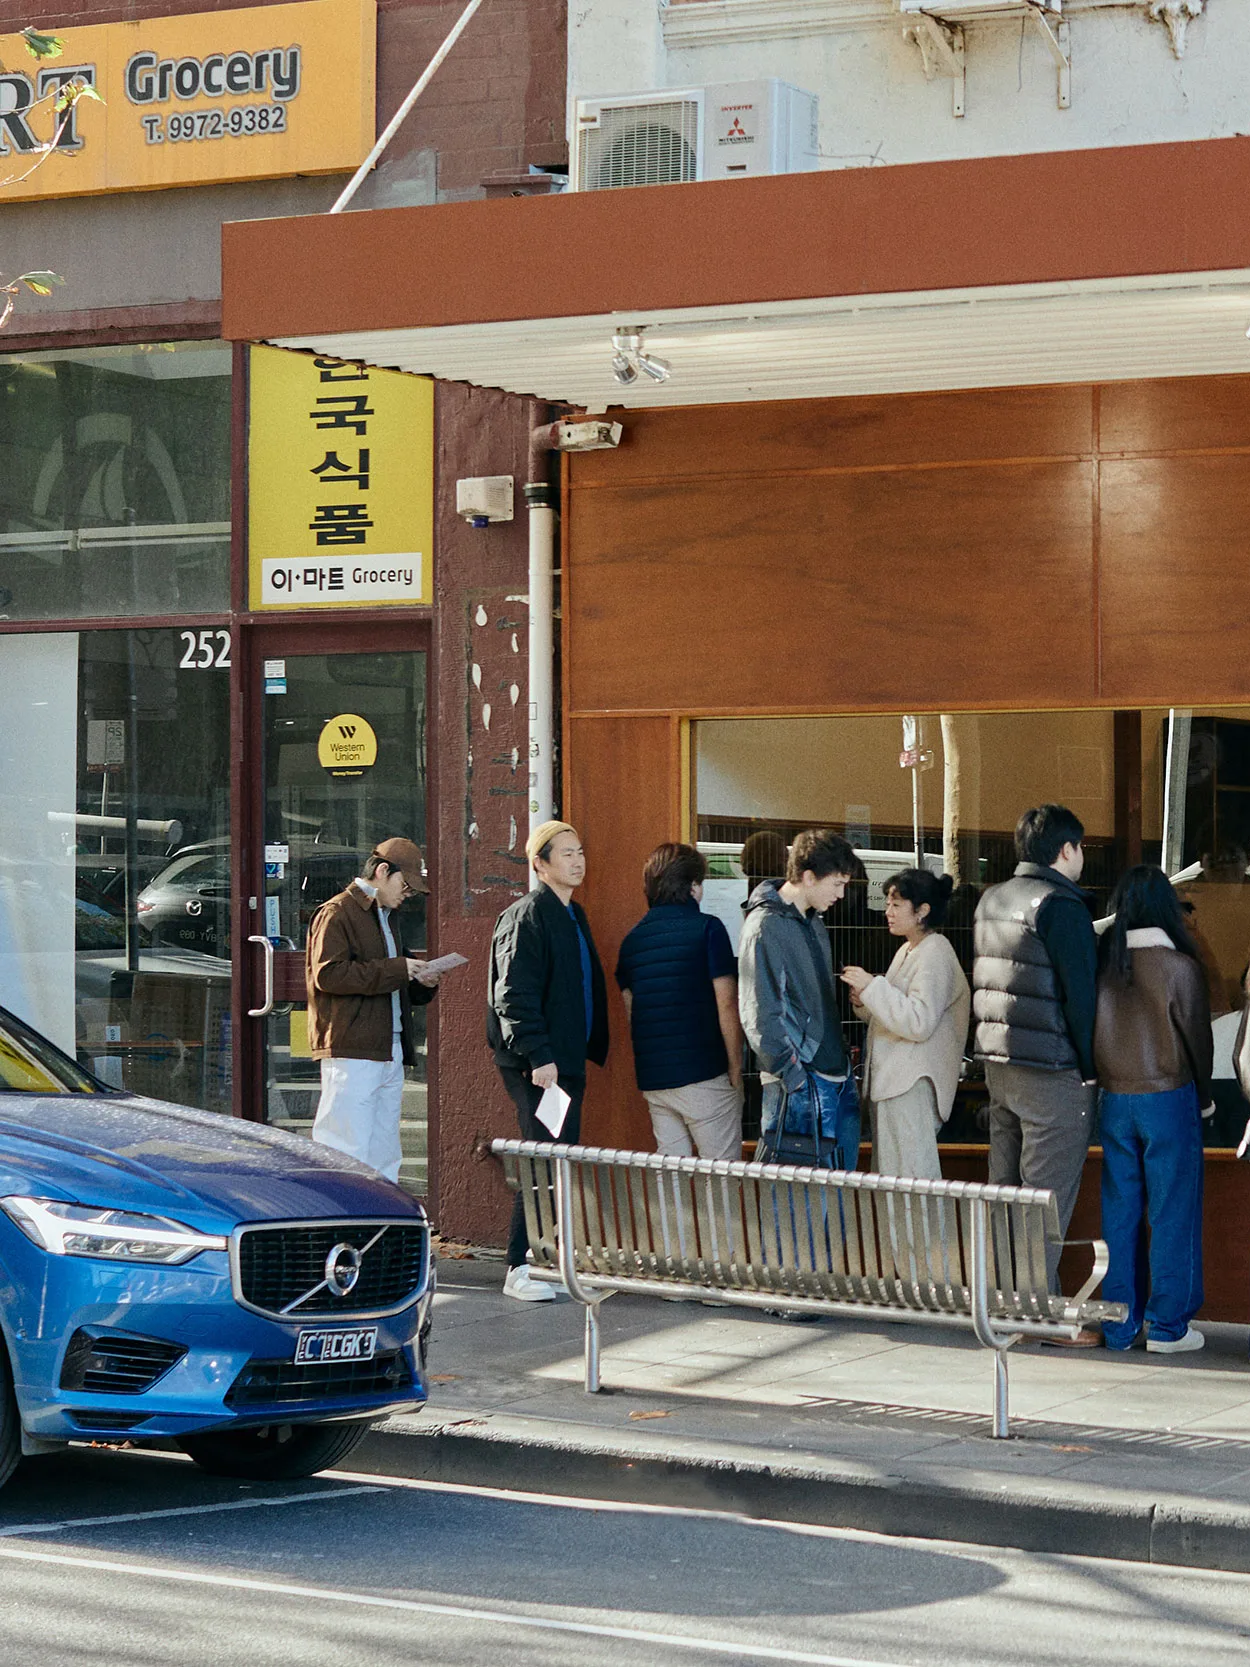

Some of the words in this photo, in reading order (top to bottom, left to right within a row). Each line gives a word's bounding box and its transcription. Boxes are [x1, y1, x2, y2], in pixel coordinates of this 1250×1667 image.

[126, 44, 301, 104] Grocery
[169, 106, 285, 139] 9972-9382
[353, 567, 413, 586] Grocery
[179, 630, 232, 669] 252
[330, 743, 366, 752] Western
[335, 752, 361, 762] Union
